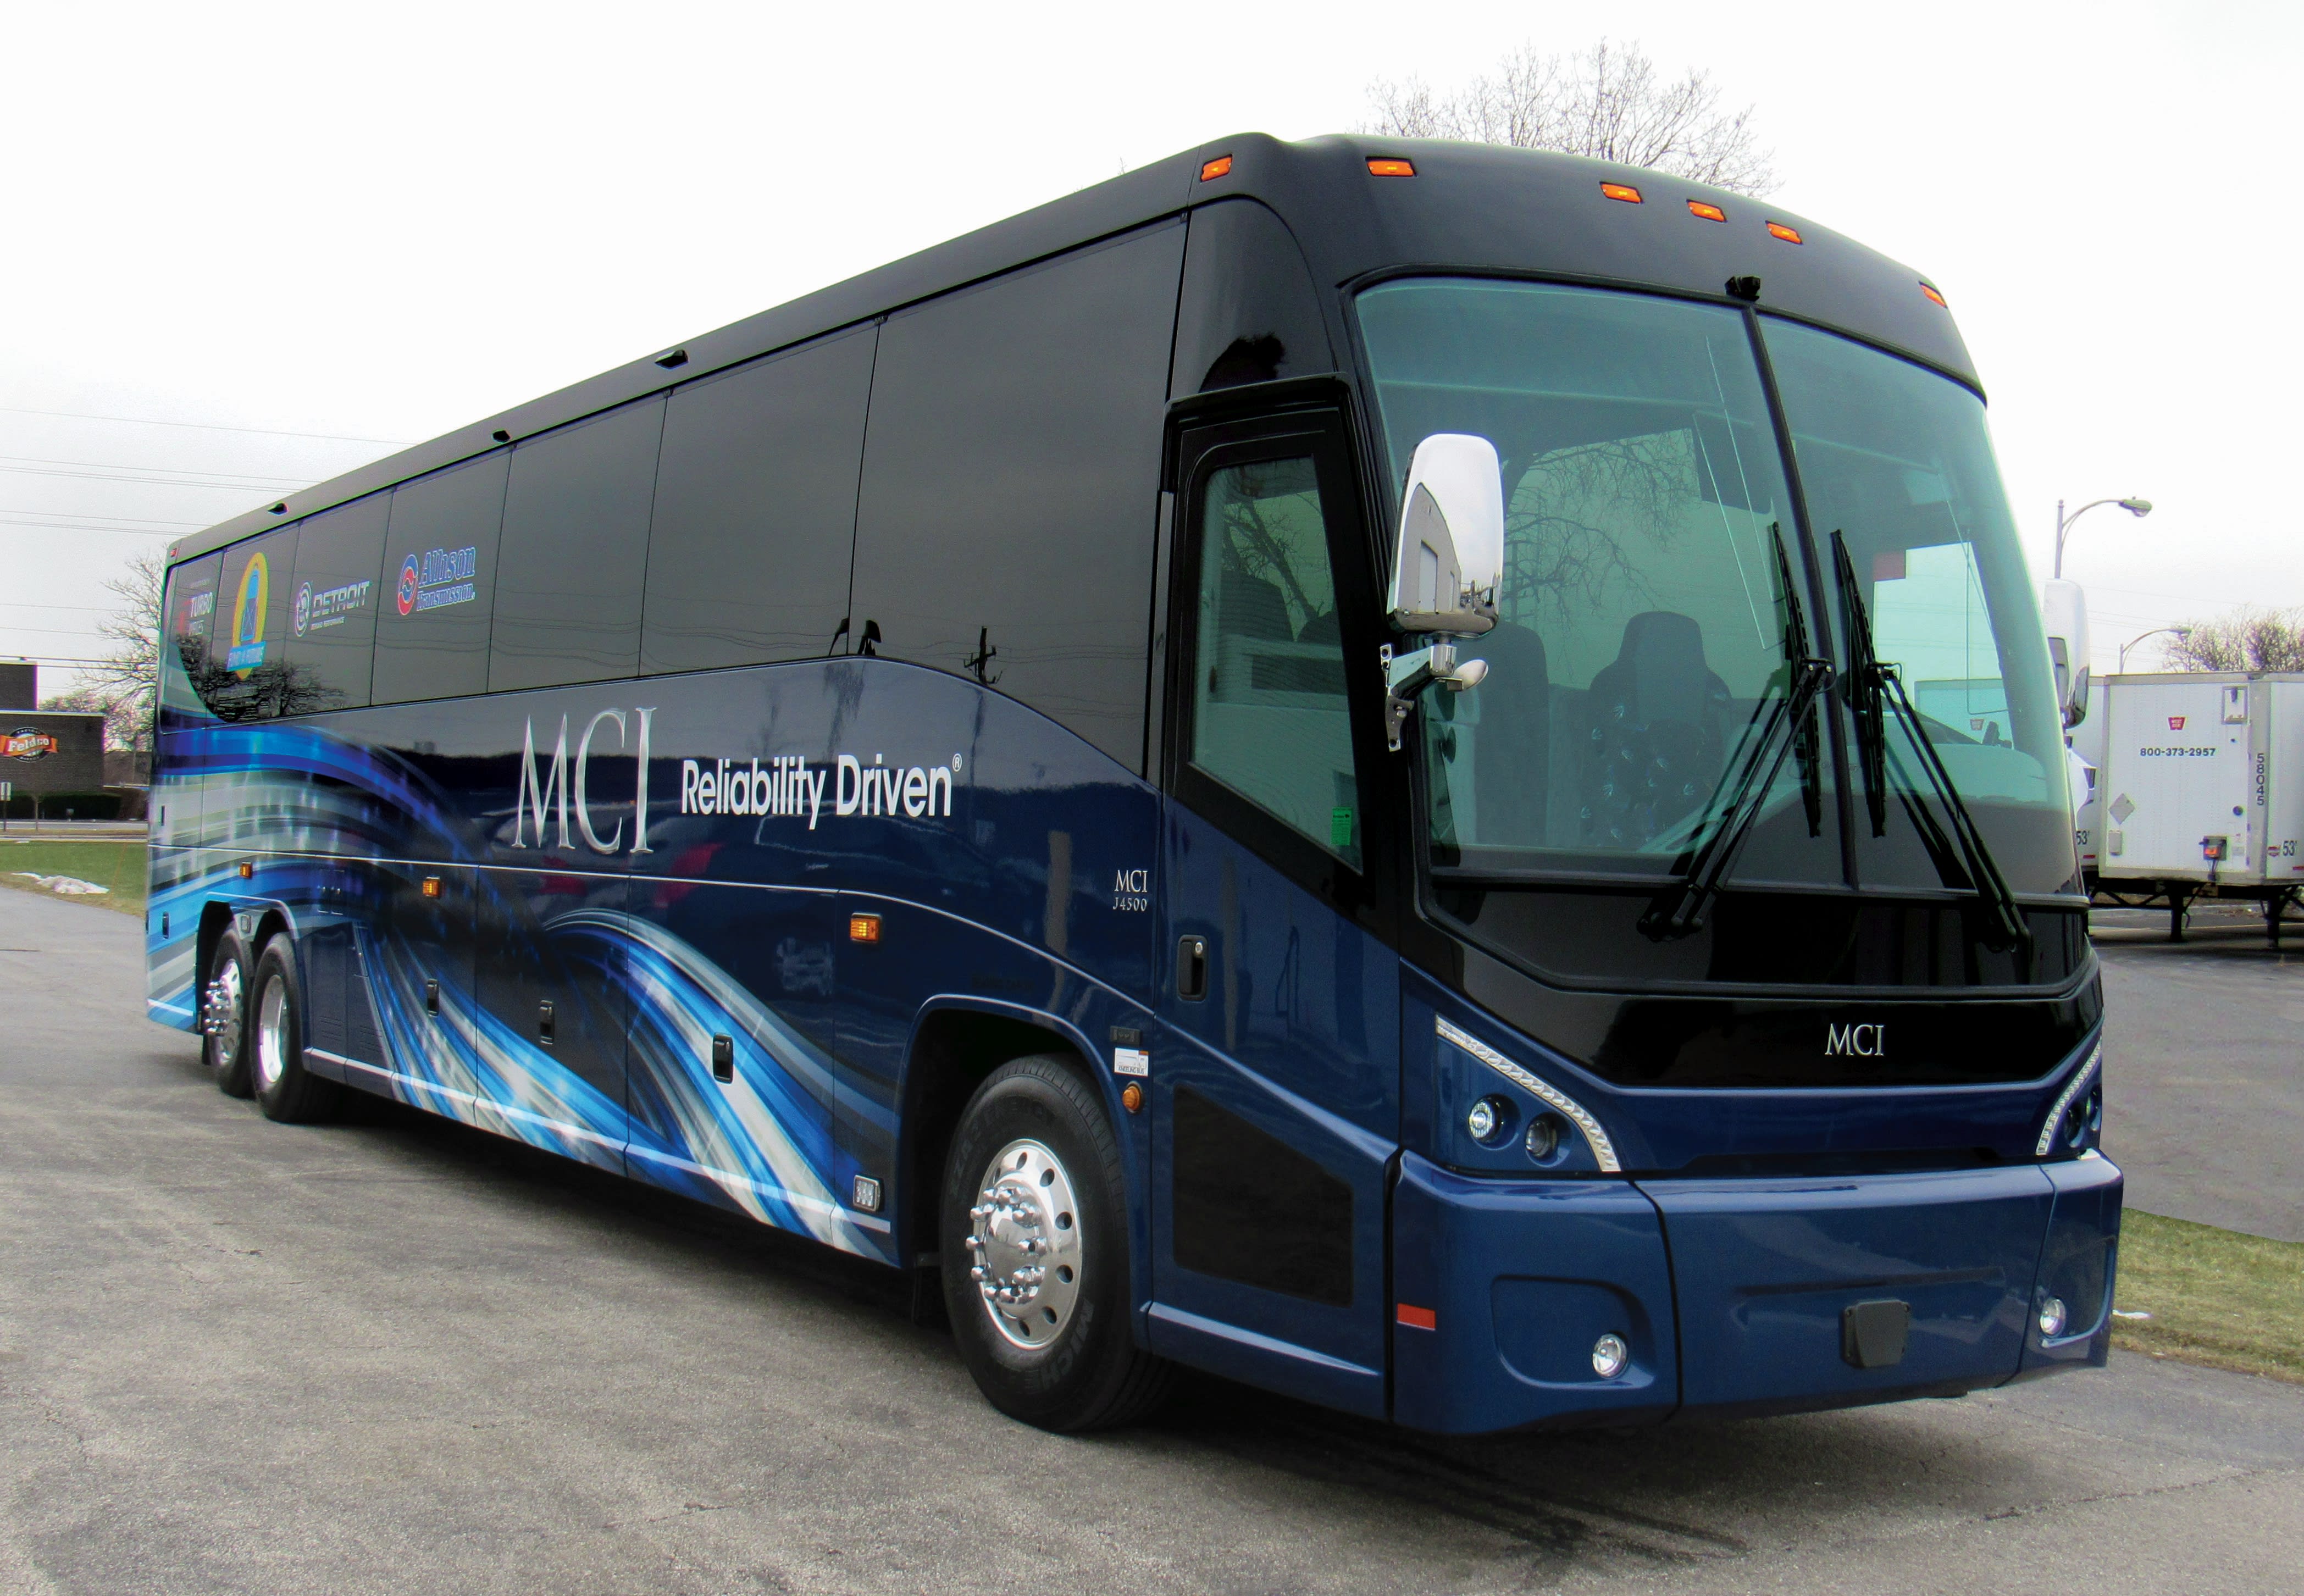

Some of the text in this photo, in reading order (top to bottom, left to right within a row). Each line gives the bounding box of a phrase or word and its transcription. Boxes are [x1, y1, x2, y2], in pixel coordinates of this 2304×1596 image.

[418, 547, 476, 588] Allison
[313, 581, 370, 618] DETROIT
[7, 737, 49, 752] Feldco
[2140, 747, 2216, 756] 800-373-2957
[511, 707, 657, 854] MCI
[682, 756, 826, 830] Reliability
[2256, 753, 2265, 806] 58045
[2283, 840, 2297, 856] 53'
[1114, 869, 1148, 893] MCI
[1112, 897, 1148, 912] J4500
[1824, 1023, 1885, 1056] MCI
